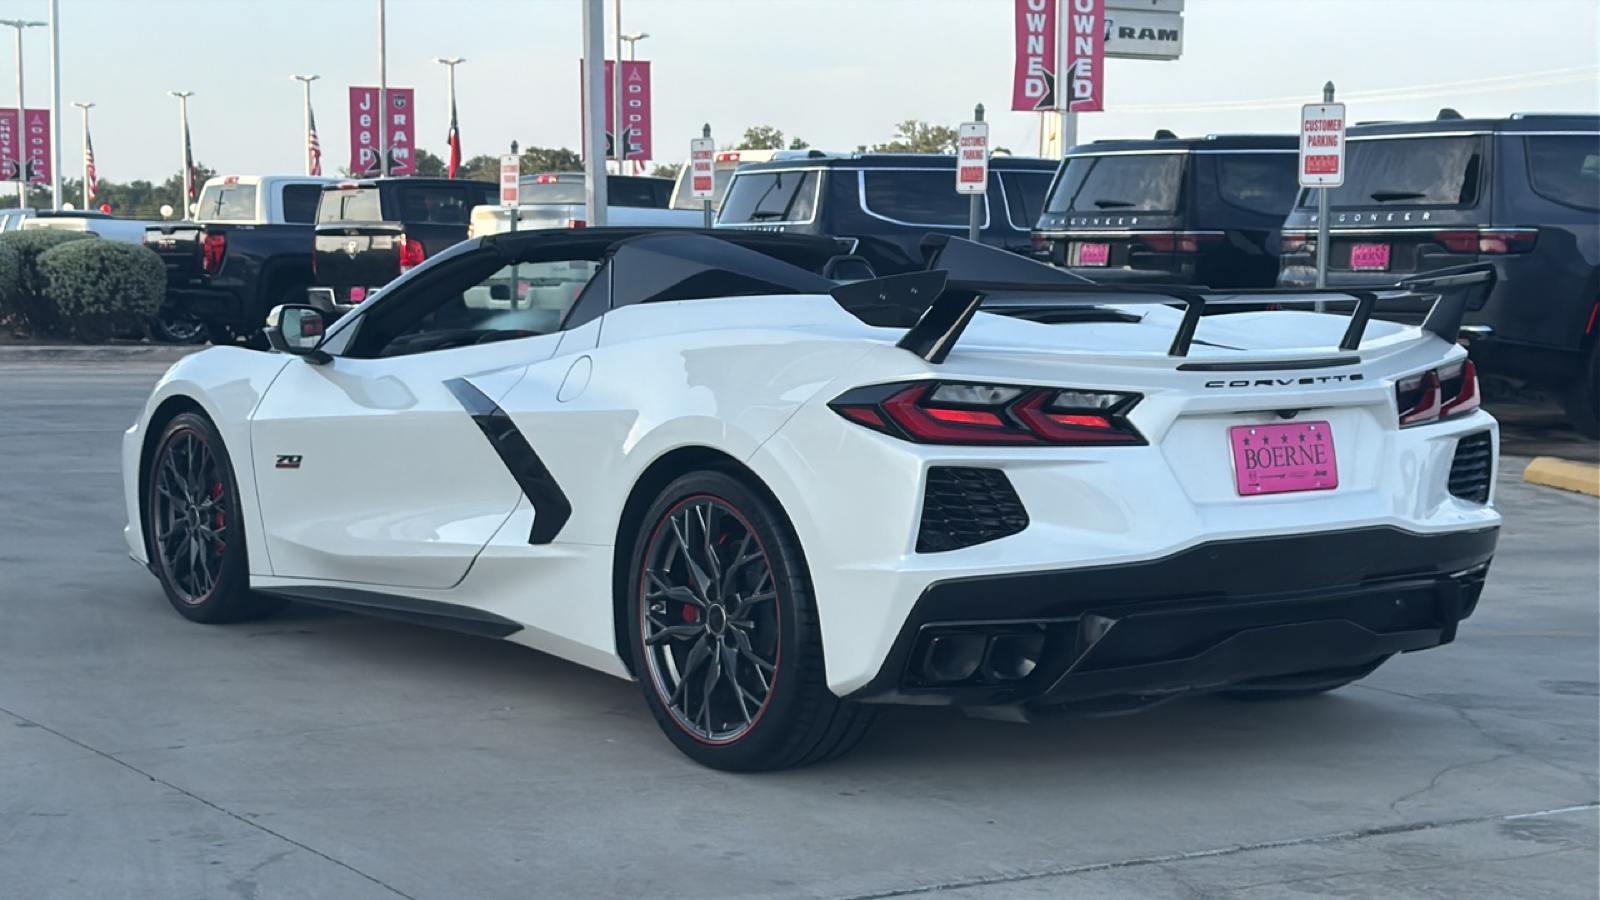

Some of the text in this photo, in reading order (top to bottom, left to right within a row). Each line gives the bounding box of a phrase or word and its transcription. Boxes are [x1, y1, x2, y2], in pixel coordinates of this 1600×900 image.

[1119, 26, 1178, 41] RAM
[360, 93, 371, 165] Jeep
[1305, 120, 1341, 131] CUSTOMER
[393, 114, 409, 159] RAM
[1308, 135, 1338, 146] PARKING
[1205, 374, 1364, 388] CORVETTE
[1245, 444, 1327, 469] BOERNE
